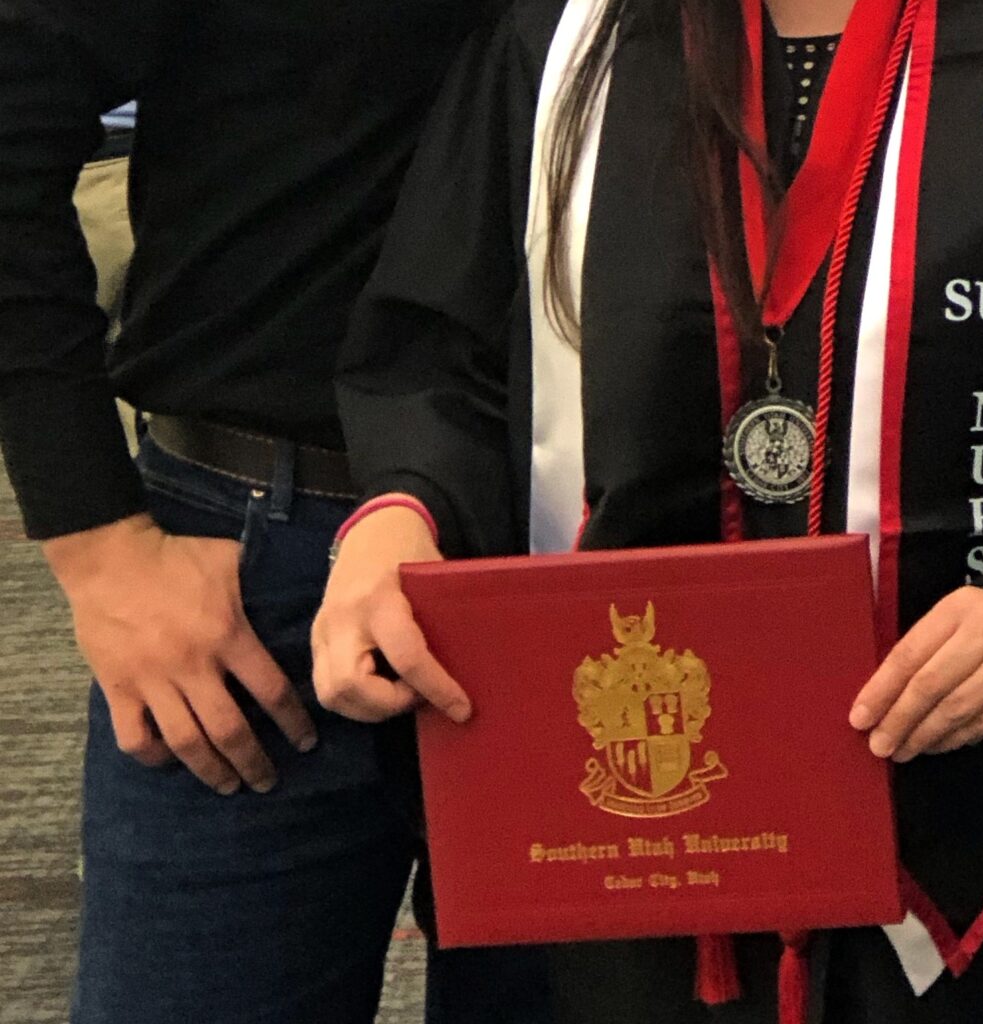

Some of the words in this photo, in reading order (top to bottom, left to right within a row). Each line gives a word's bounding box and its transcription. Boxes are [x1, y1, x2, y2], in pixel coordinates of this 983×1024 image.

[530, 843, 619, 863] Southern
[628, 836, 674, 858] Utah
[682, 832, 788, 853] University
